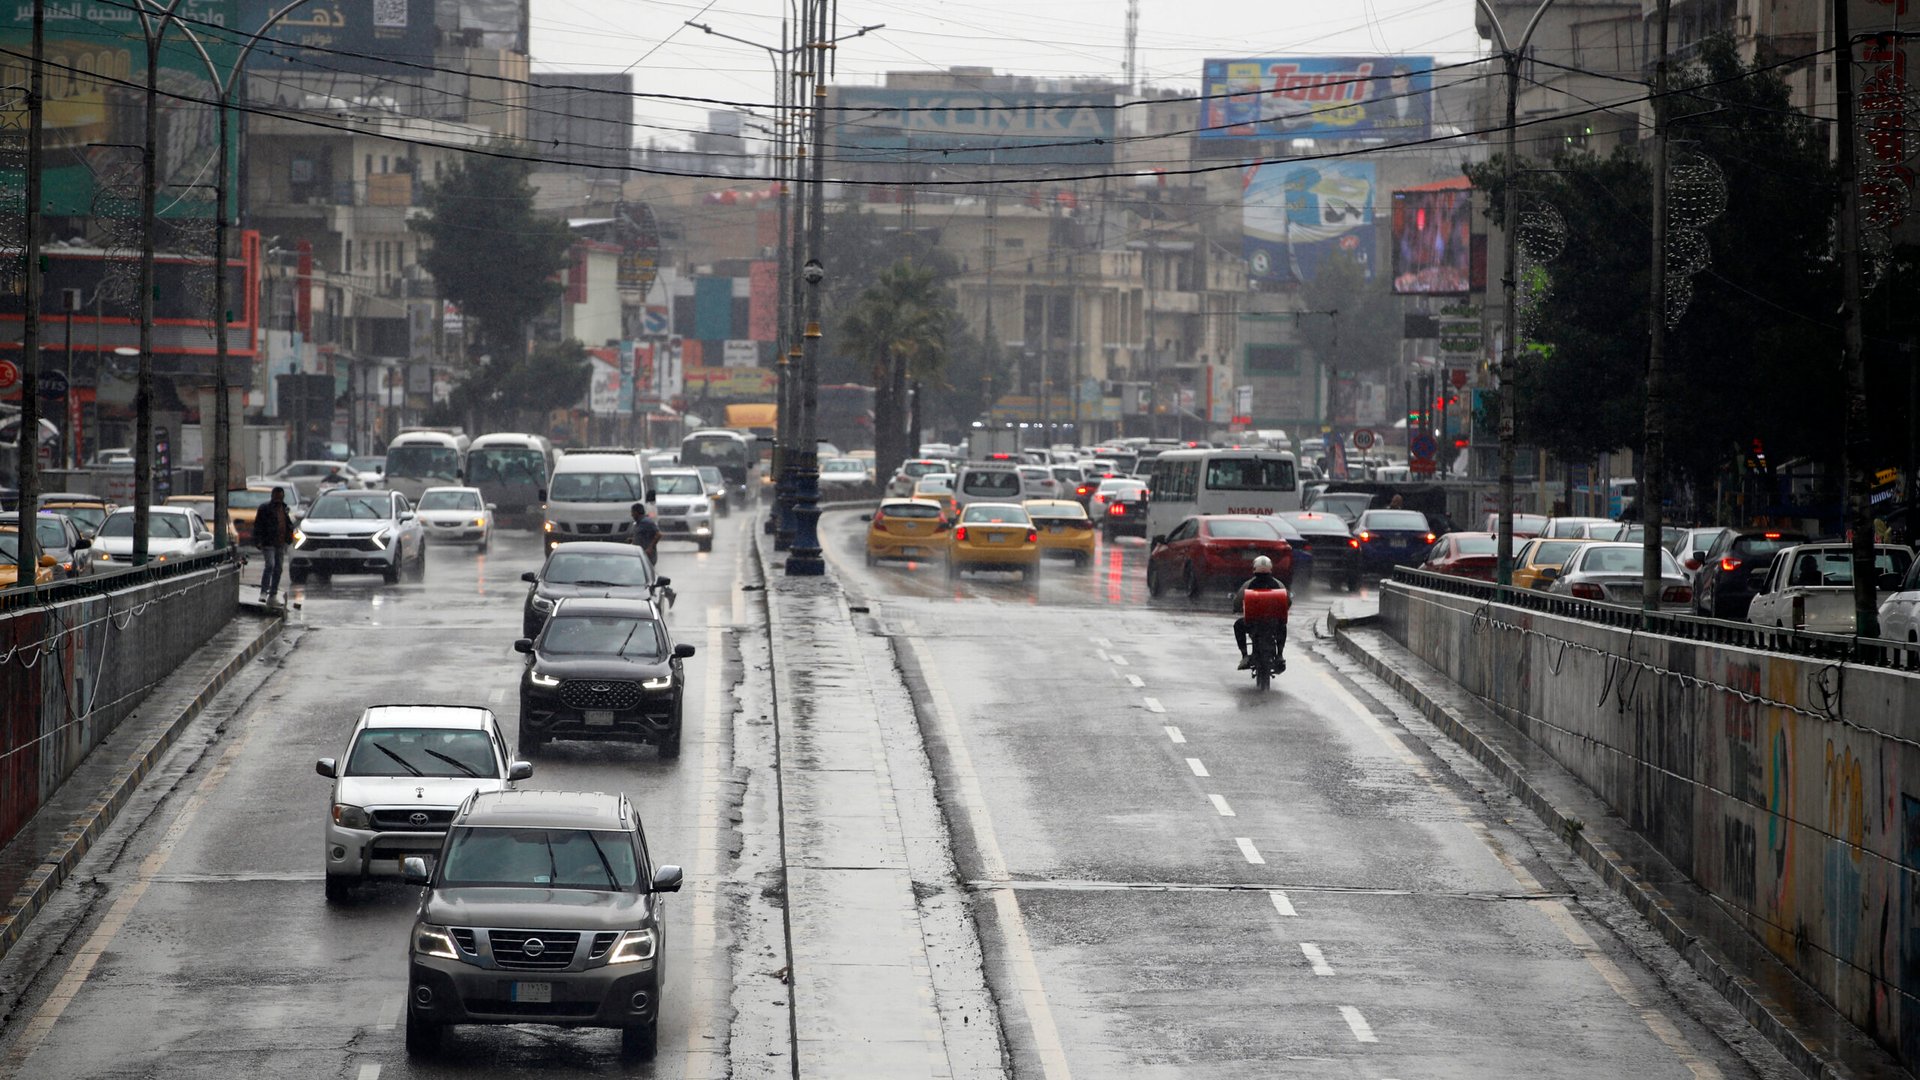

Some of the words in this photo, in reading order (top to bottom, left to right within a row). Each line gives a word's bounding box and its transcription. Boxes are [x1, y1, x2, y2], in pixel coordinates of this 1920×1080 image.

[907, 96, 1106, 135] KONKA
[1357, 434, 1371, 444] 60
[1228, 506, 1273, 516] NISSAN
